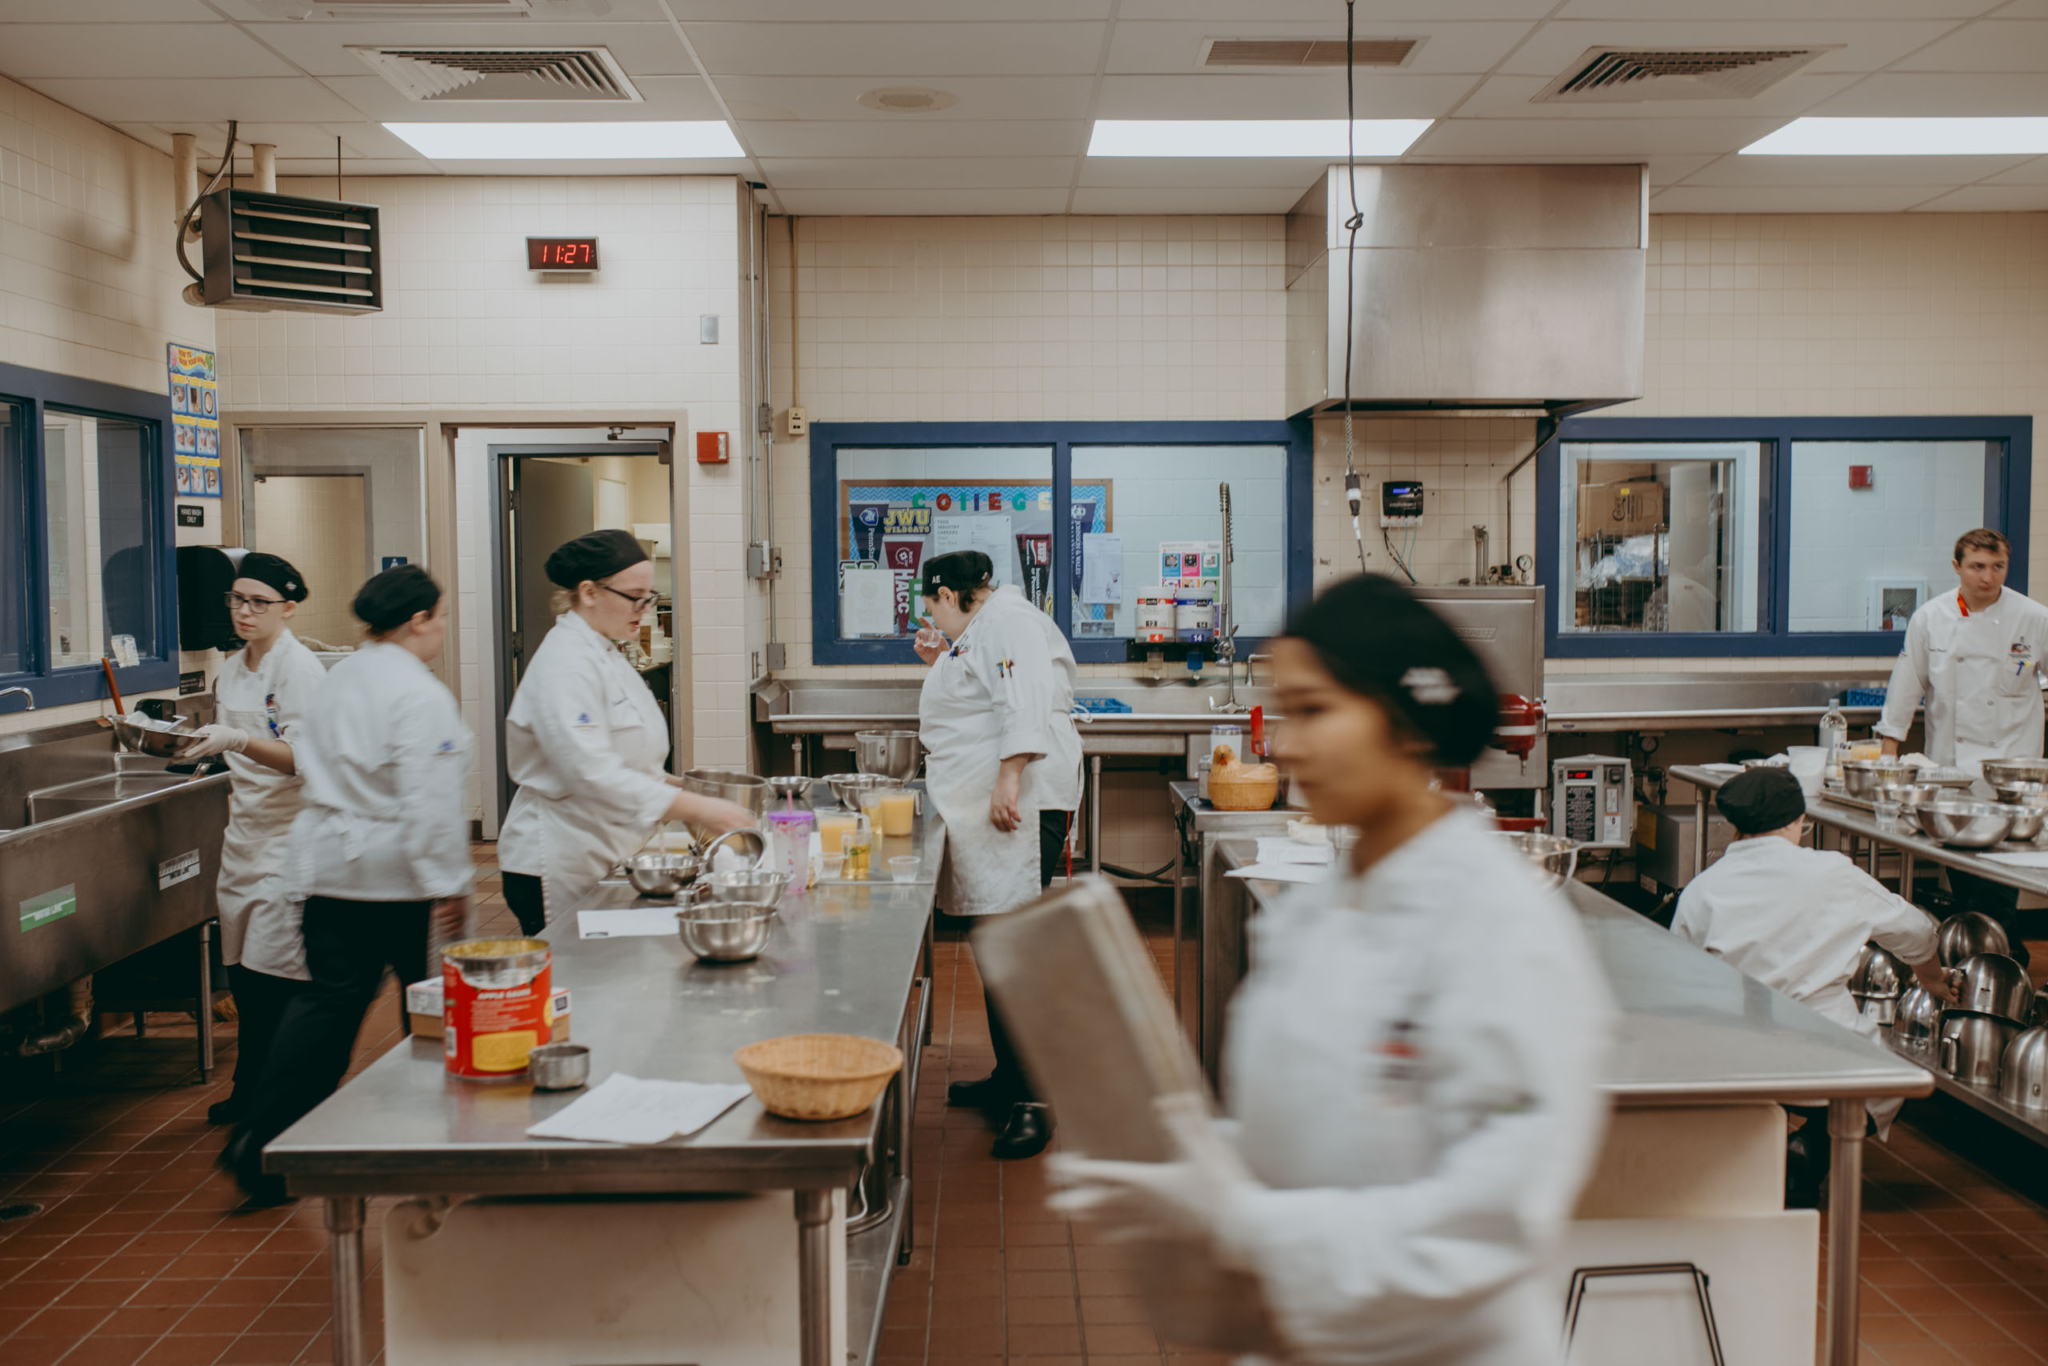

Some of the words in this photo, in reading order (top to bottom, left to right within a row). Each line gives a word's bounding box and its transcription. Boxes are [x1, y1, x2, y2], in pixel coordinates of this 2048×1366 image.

[543, 244, 590, 264] 11:27
[180, 508, 191, 516] HAND
[884, 507, 930, 526] JWU
[186, 515, 197, 524] ONLY
[884, 526, 930, 534] WILDCATS
[894, 568, 915, 615] HACC
[1193, 634, 1203, 642] 14
